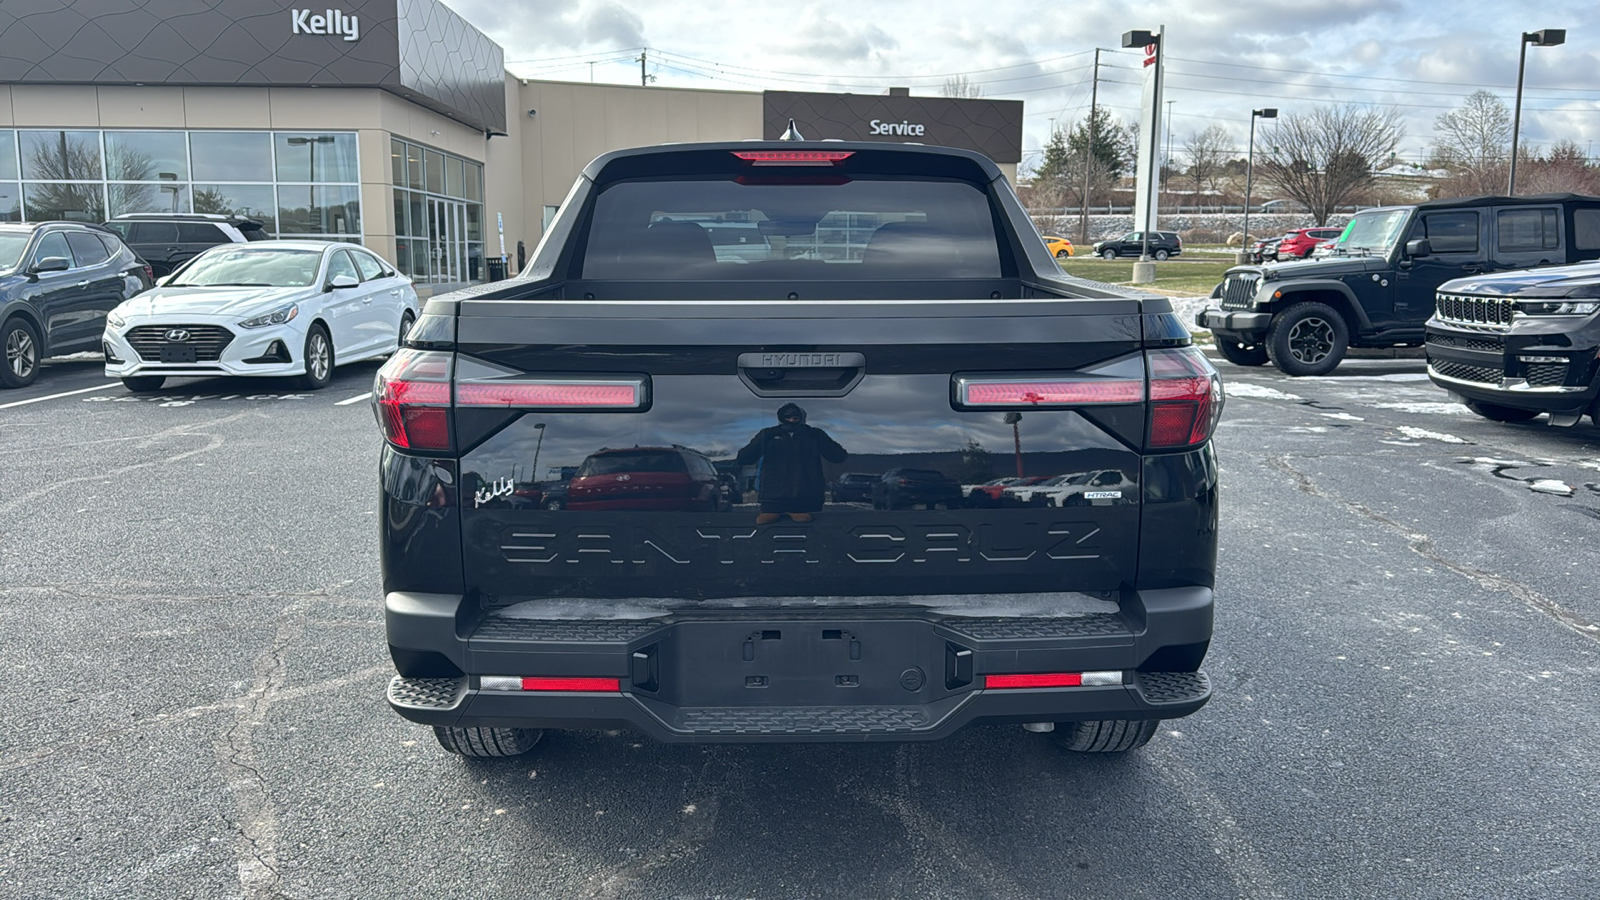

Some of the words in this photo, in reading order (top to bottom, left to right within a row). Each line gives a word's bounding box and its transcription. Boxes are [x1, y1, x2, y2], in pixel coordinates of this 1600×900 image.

[292, 9, 359, 41] Kelly
[869, 119, 925, 136] Service
[762, 354, 840, 366] HYUNDAI
[474, 476, 514, 508] Kelly
[1086, 491, 1120, 499] HTRAC
[500, 524, 819, 563] SANTA
[846, 521, 1101, 563] CRUZ
